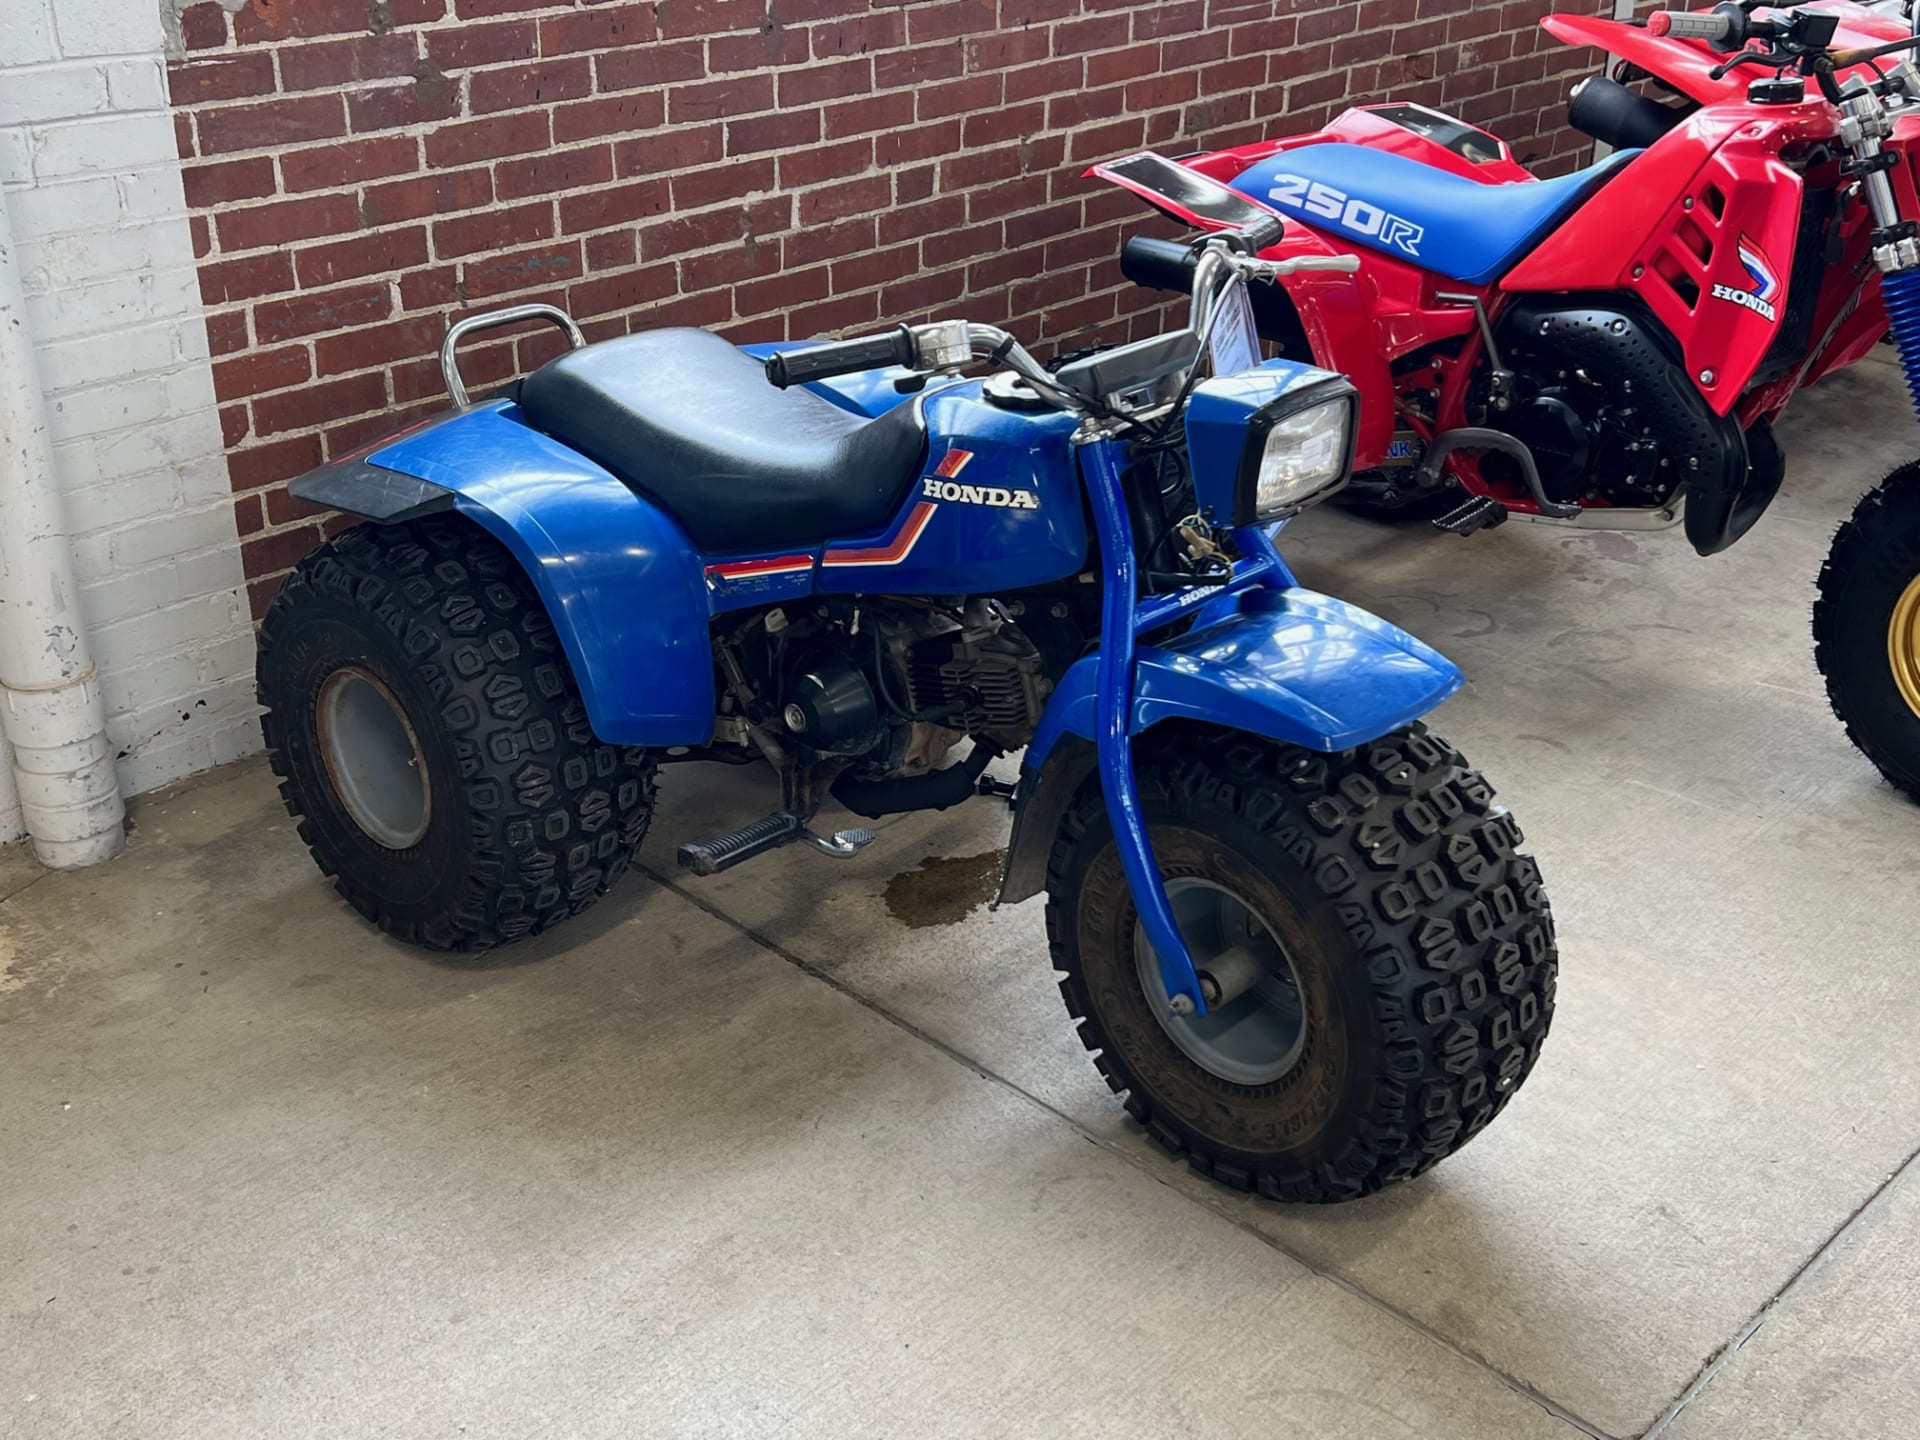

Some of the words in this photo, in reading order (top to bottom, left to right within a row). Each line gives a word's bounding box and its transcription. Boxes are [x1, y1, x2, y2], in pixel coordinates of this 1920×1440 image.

[1268, 173, 1424, 257] 250R
[1711, 283, 1776, 322] HONDA
[922, 478, 1040, 510] HONDA
